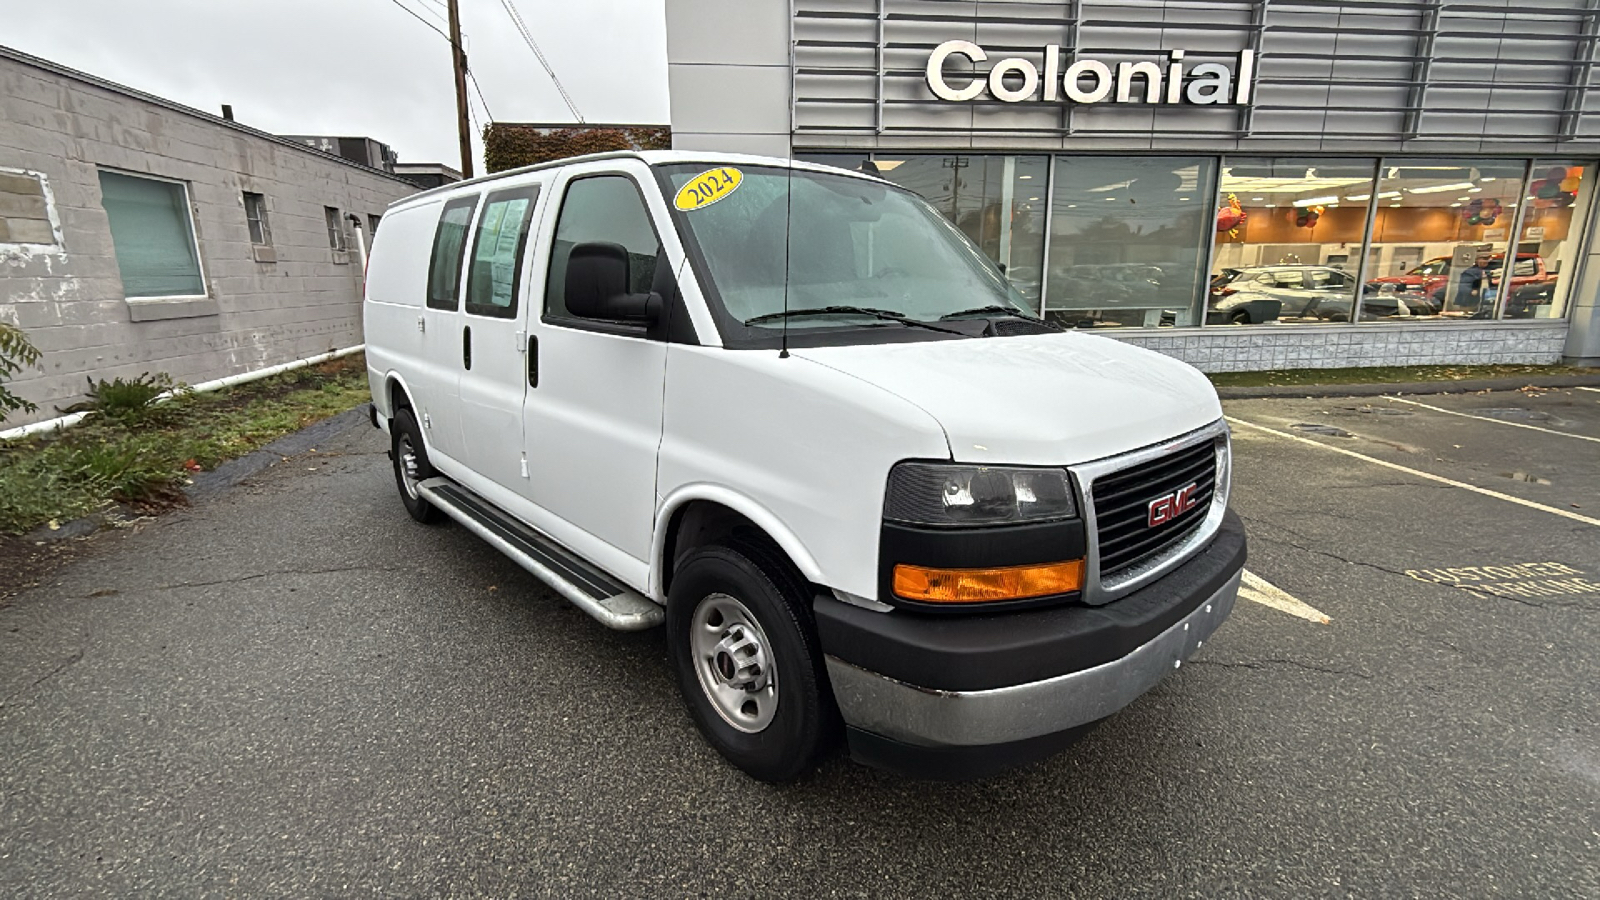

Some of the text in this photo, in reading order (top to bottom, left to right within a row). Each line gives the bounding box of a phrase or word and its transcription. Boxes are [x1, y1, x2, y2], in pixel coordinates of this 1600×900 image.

[926, 40, 1254, 104] Colonial
[687, 169, 734, 205] 2024
[1148, 482, 1197, 527] GMC
[1405, 562, 1586, 583] CUSTOMER
[1455, 578, 1600, 599] PARKING
